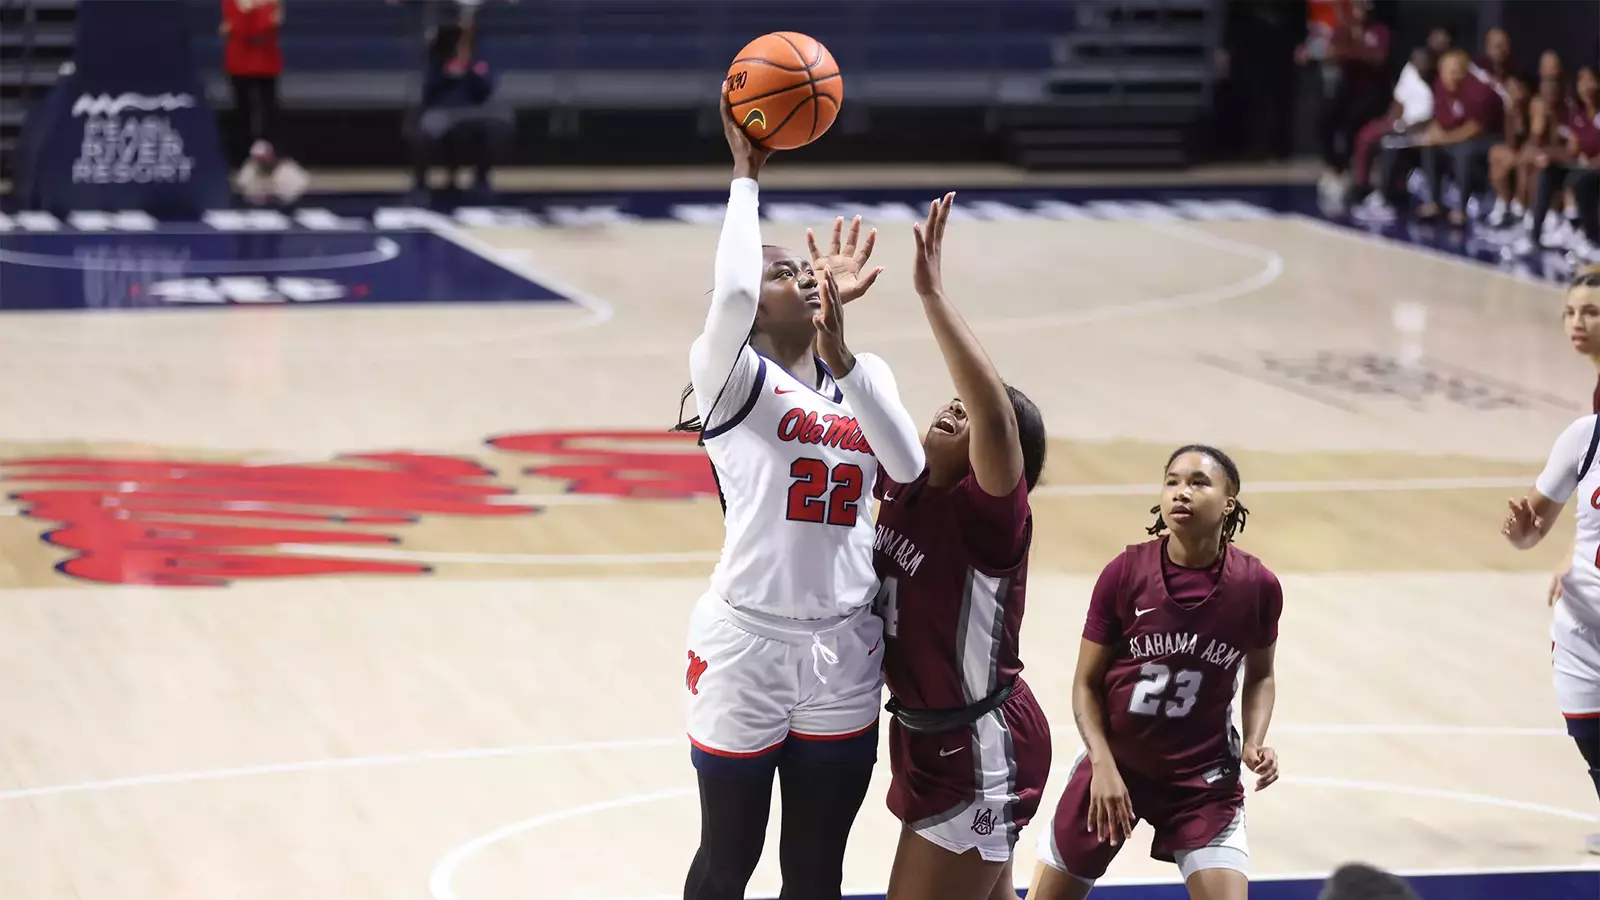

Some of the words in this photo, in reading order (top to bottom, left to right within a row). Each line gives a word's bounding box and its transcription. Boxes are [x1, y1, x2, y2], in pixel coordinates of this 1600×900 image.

[84, 116, 170, 141] PEARL
[81, 137, 184, 163] RIVER
[72, 158, 193, 184] RESORT
[777, 407, 824, 445] Ole
[786, 457, 863, 527] 22
[893, 538, 925, 577] A&M
[1129, 632, 1198, 659] ALABAMA
[1200, 638, 1240, 670] A&M
[1128, 663, 1203, 717] 23
